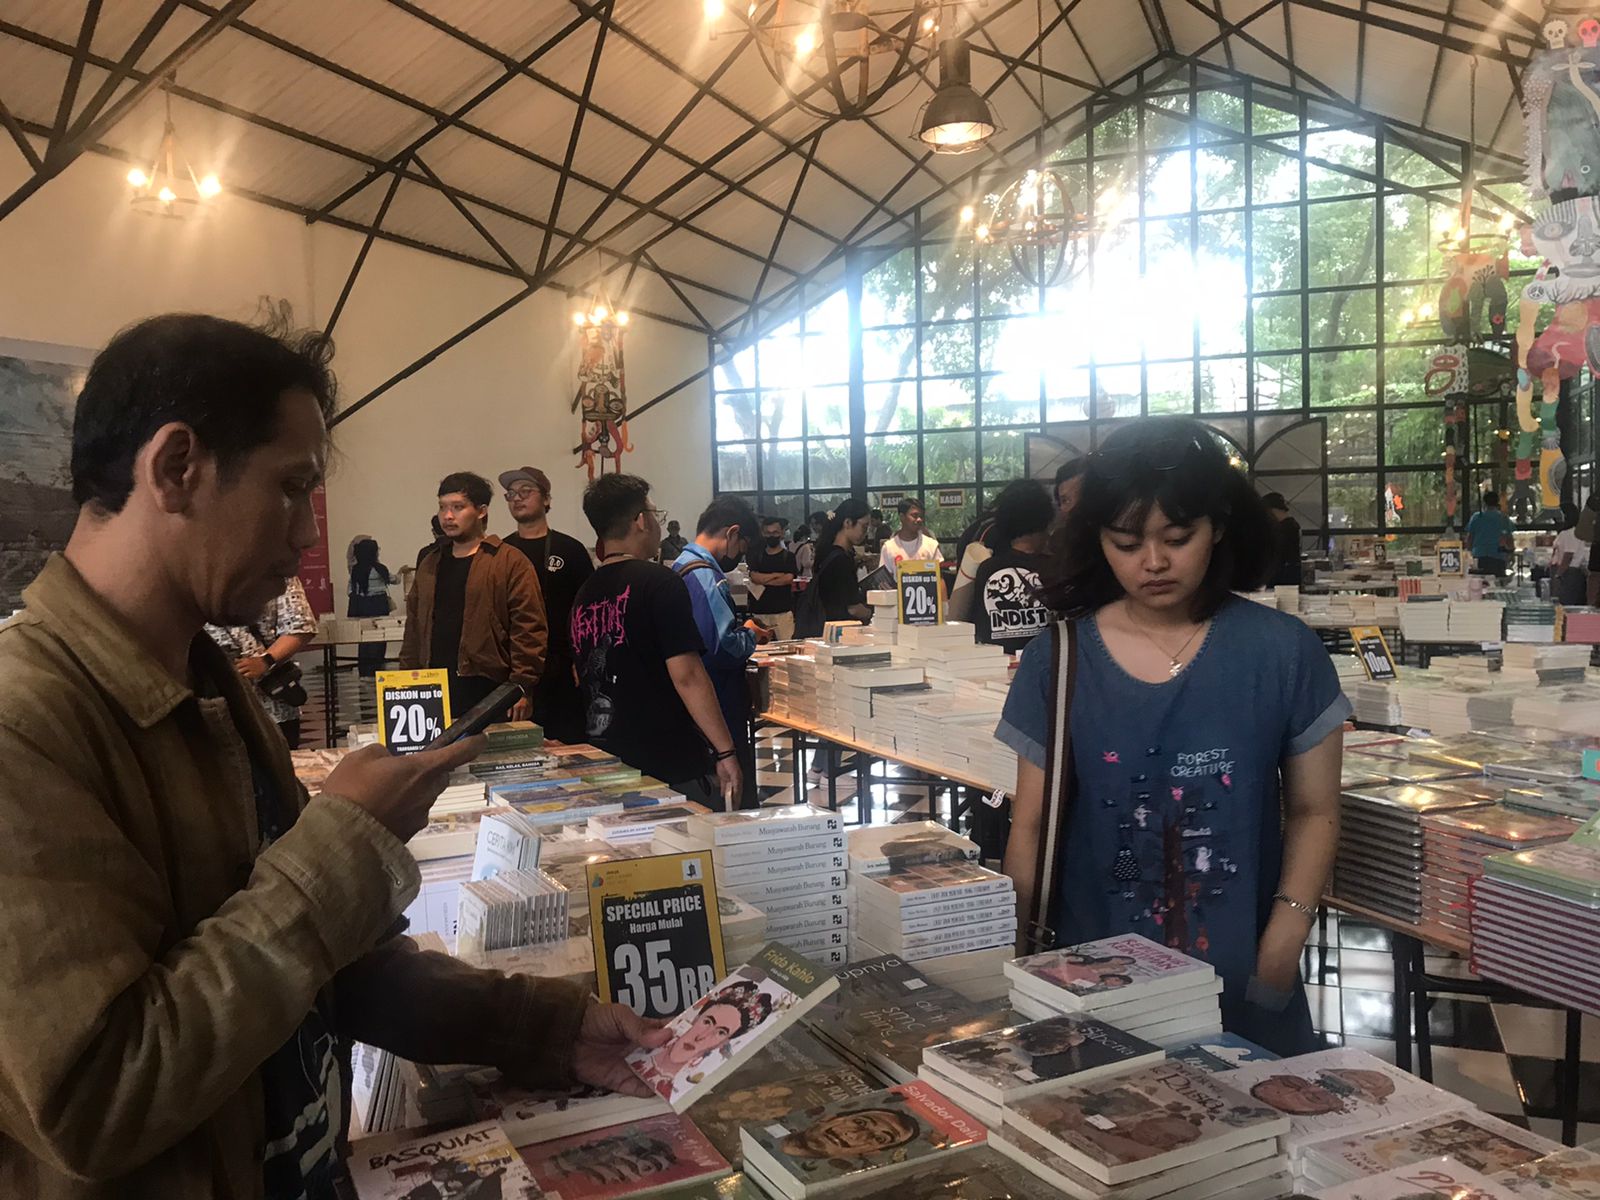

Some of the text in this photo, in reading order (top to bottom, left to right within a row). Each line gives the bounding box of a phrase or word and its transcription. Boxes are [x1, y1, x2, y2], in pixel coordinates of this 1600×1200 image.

[940, 495, 962, 505] KASIR
[905, 586, 937, 615] 20%
[385, 689, 443, 700] DISKON up to
[390, 704, 442, 743] 20%
[1170, 761, 1236, 777] CREATURE
[1177, 748, 1230, 765] FOREST
[606, 895, 703, 922] SPECIAL PRICE
[629, 917, 684, 934] Harga Mulai
[763, 949, 788, 968] Frida
[785, 962, 815, 984] Kahlo
[904, 1085, 954, 1120] Salvador
[368, 1126, 498, 1170] BASQUIAT
